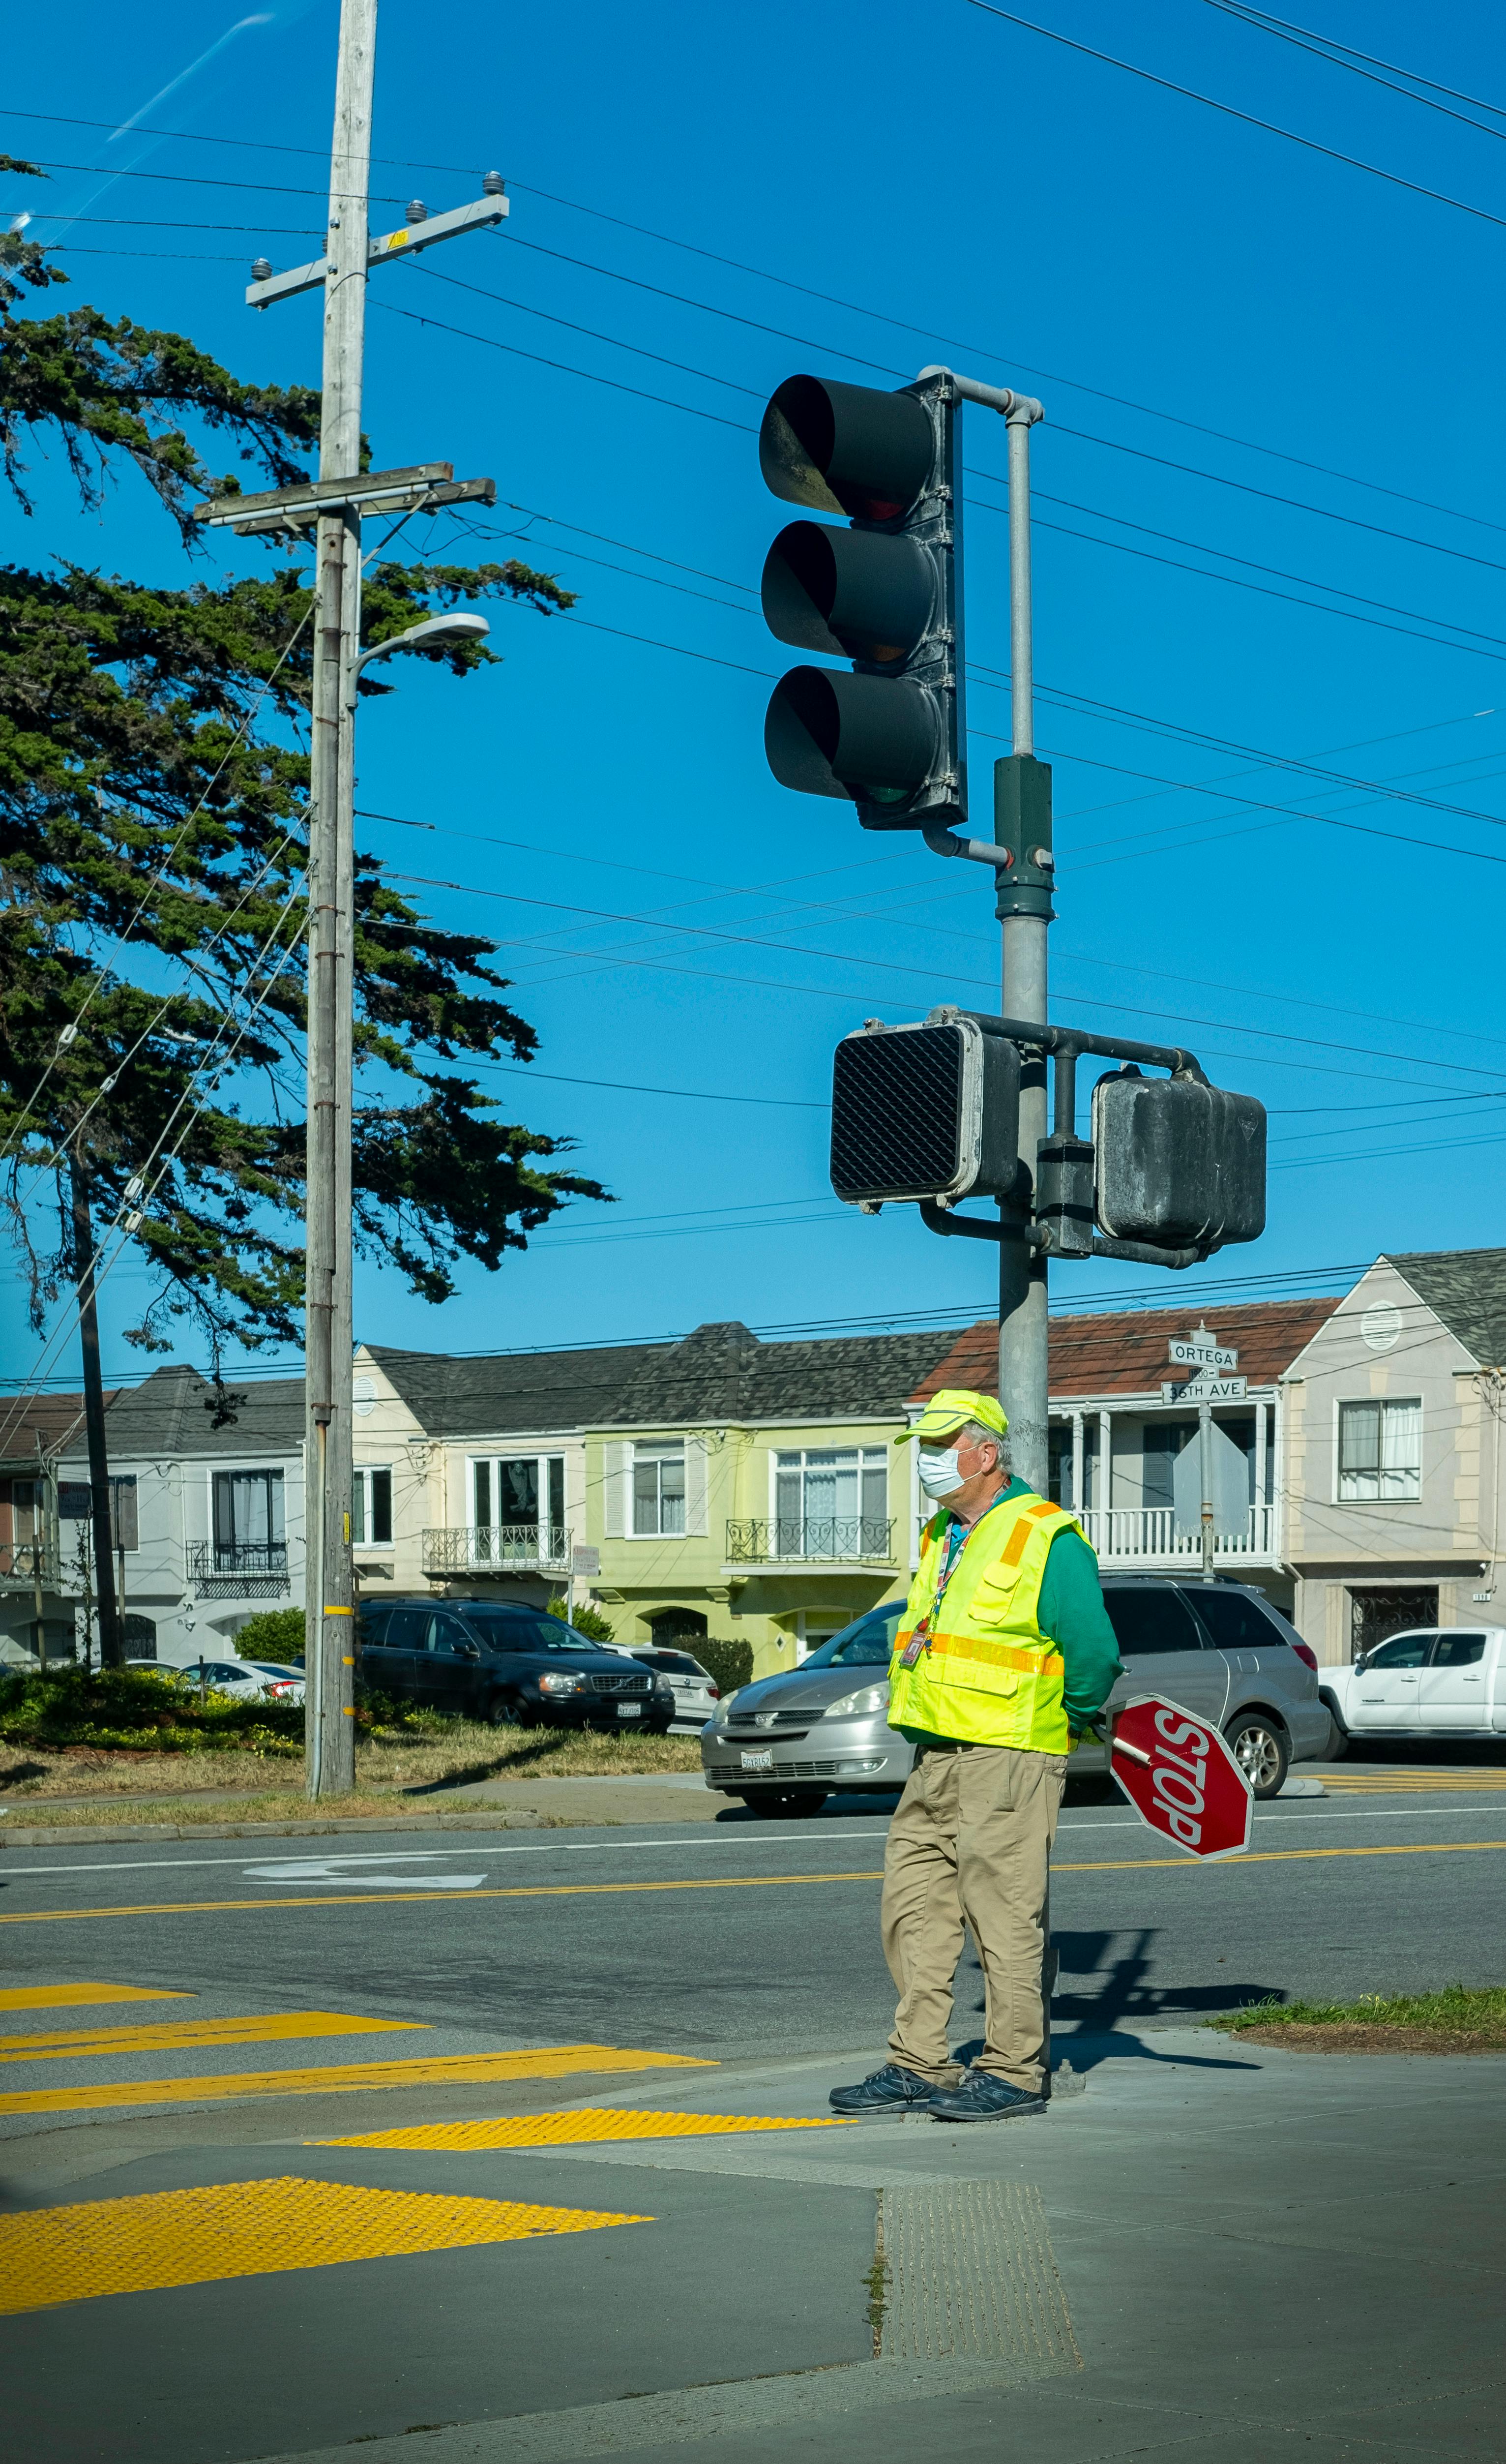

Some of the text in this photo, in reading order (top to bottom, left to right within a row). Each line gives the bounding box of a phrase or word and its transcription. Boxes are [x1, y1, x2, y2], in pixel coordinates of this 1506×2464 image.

[1176, 1346, 1233, 1366] ORTEGA
[1191, 1369, 1208, 1380] 1900
[1170, 1382, 1240, 1399] 36TH AVE
[1152, 1709, 1210, 1845] STOP
